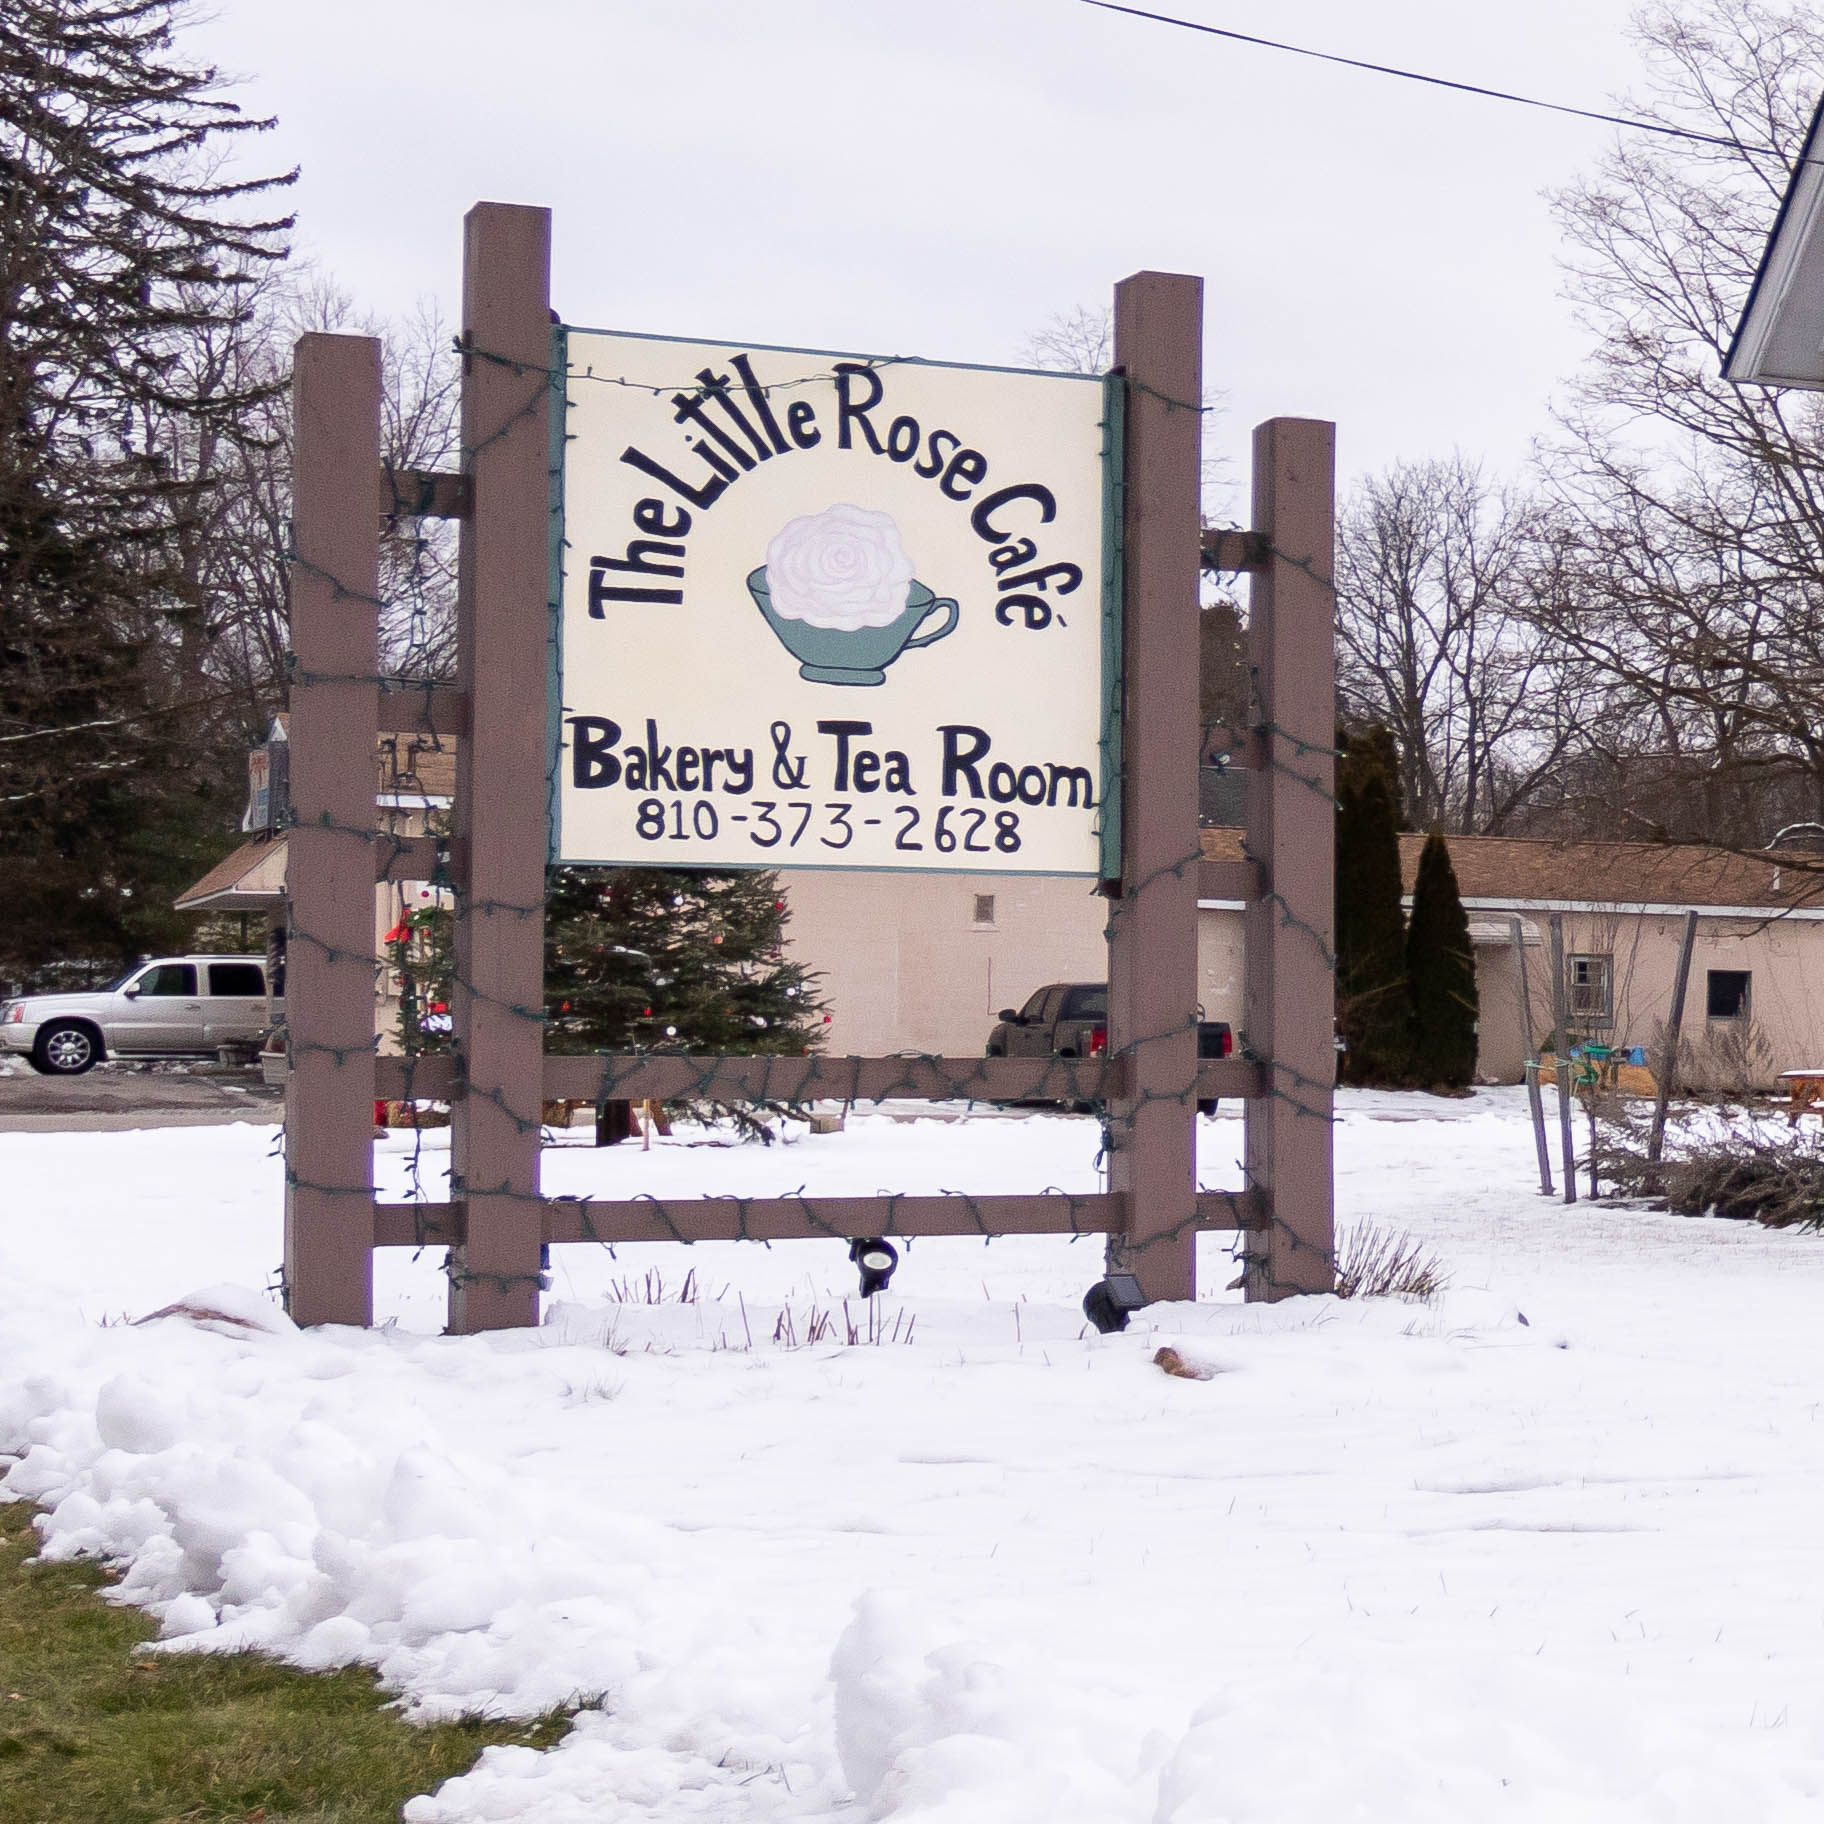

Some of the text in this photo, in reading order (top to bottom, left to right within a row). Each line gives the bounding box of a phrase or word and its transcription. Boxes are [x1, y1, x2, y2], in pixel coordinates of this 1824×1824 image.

[588, 353, 1083, 629] The Little Rose Café
[565, 716, 1095, 809] Bakery & Tea Room
